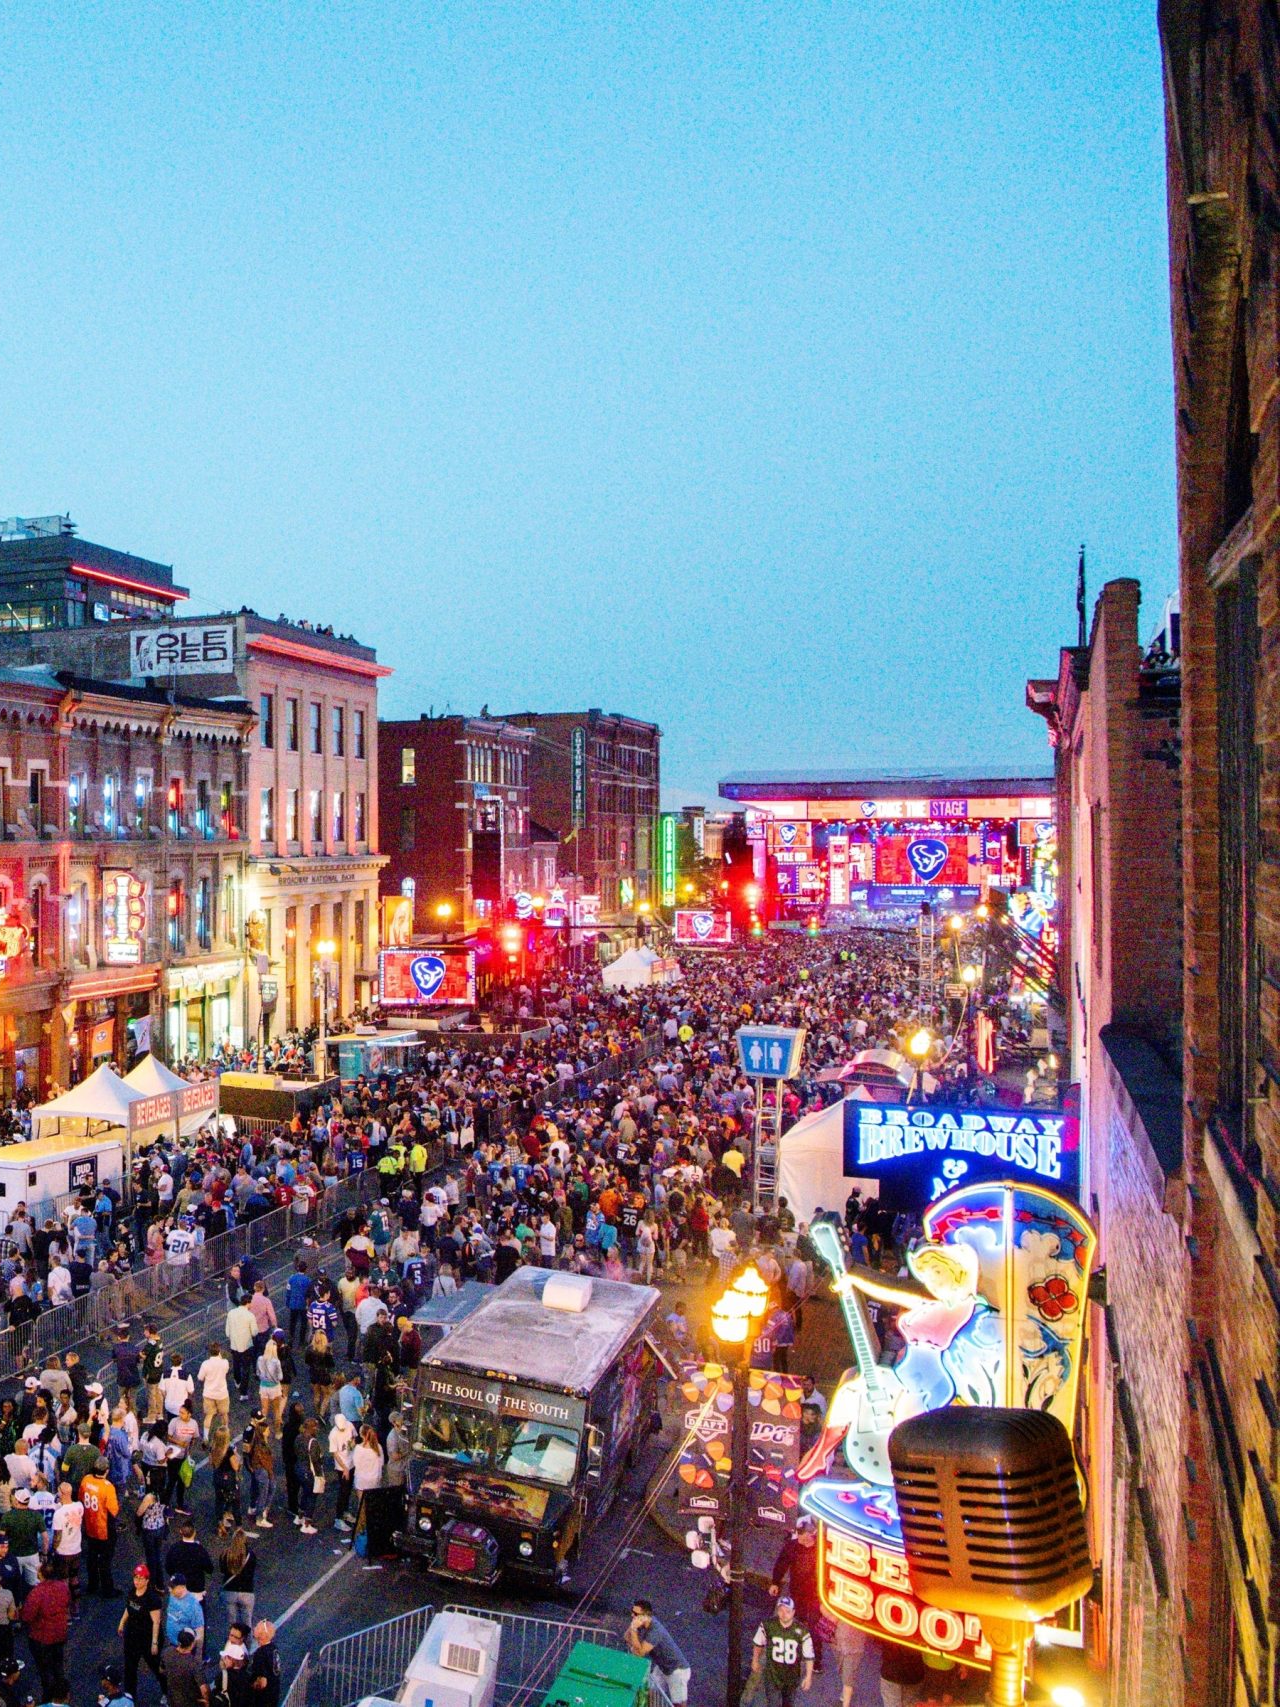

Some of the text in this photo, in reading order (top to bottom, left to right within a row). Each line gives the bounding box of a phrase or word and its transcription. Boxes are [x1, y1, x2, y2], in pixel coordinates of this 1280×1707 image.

[156, 630, 227, 648] OLE
[157, 646, 228, 664] RED
[932, 801, 965, 816] STAGE
[183, 1085, 215, 1112] BEVERAGES
[136, 1095, 171, 1126] BEVERAGES
[858, 1107, 1065, 1136] BROADWAY
[857, 1123, 1062, 1180] BREWHOUSE
[75, 1163, 91, 1176] BUD
[942, 1158, 968, 1179] &
[623, 1215, 637, 1226] 26
[171, 1239, 189, 1253] 20
[312, 1314, 326, 1329] 64
[430, 1380, 569, 1420] THE SOUL OF THE SOUTH
[84, 1492, 99, 1512] 88
[692, 1499, 717, 1508] LOWE'S
[771, 1636, 799, 1665] 28
